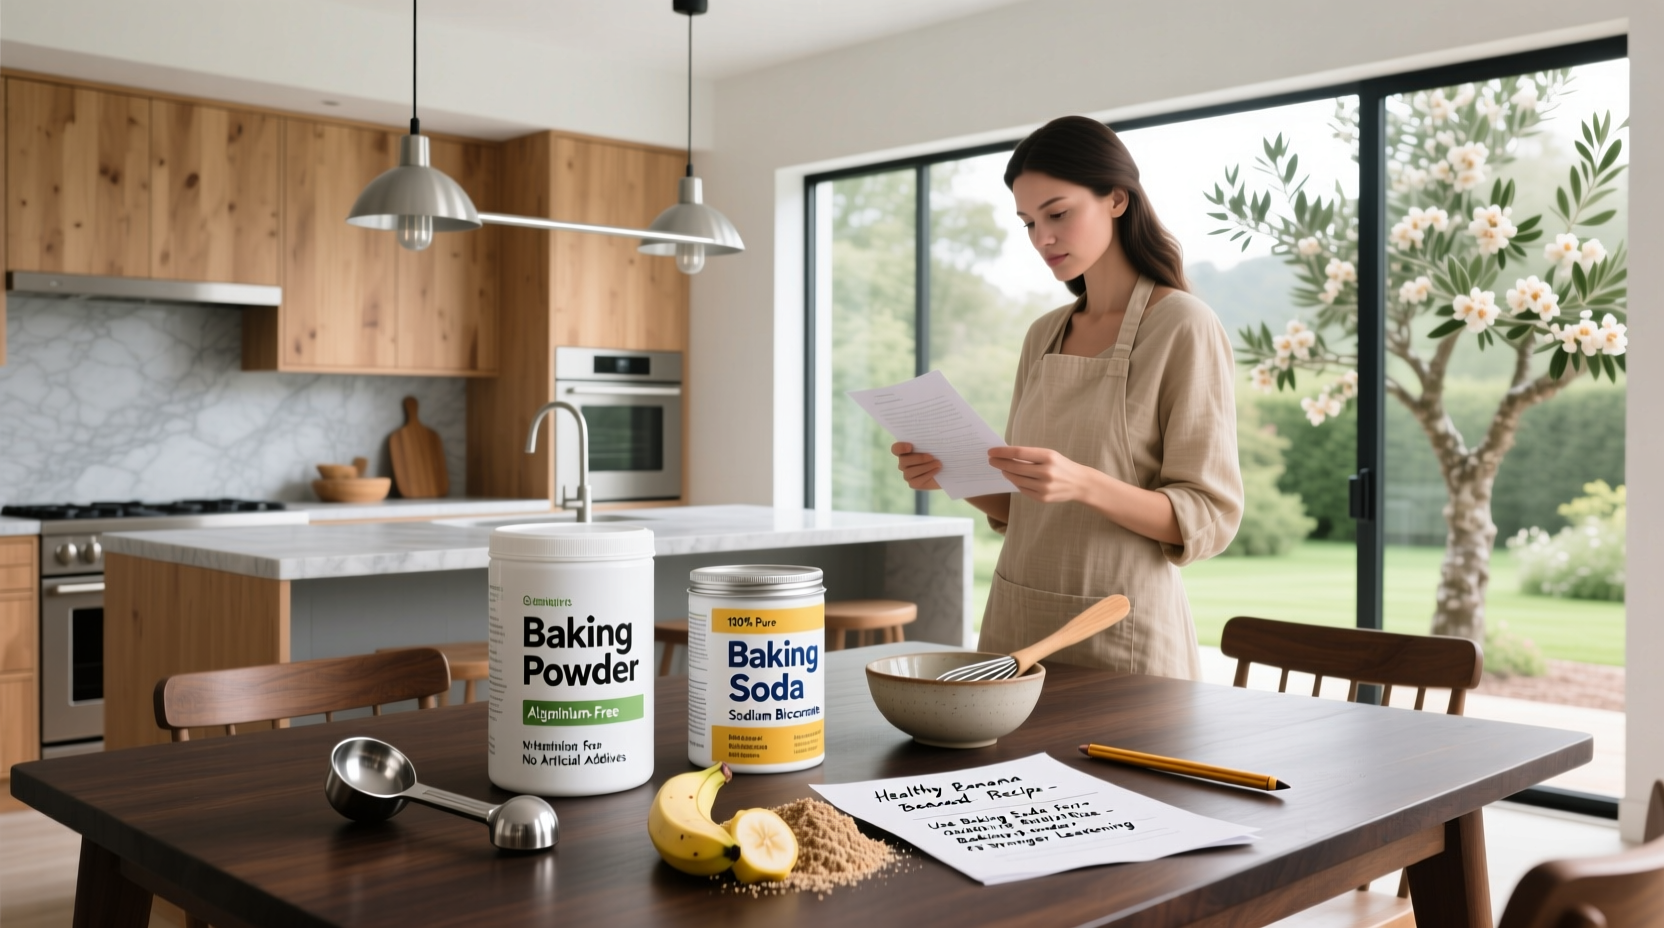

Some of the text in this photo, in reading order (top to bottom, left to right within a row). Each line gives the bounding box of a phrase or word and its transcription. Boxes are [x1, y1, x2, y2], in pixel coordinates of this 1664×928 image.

[523, 615, 632, 655] Baking
[755, 617, 777, 627] Pure
[523, 652, 639, 687] Powder
[728, 640, 818, 673] Baking
[729, 673, 804, 702] Soda
[522, 754, 537, 765] No
[875, 784, 942, 803] Healthy
